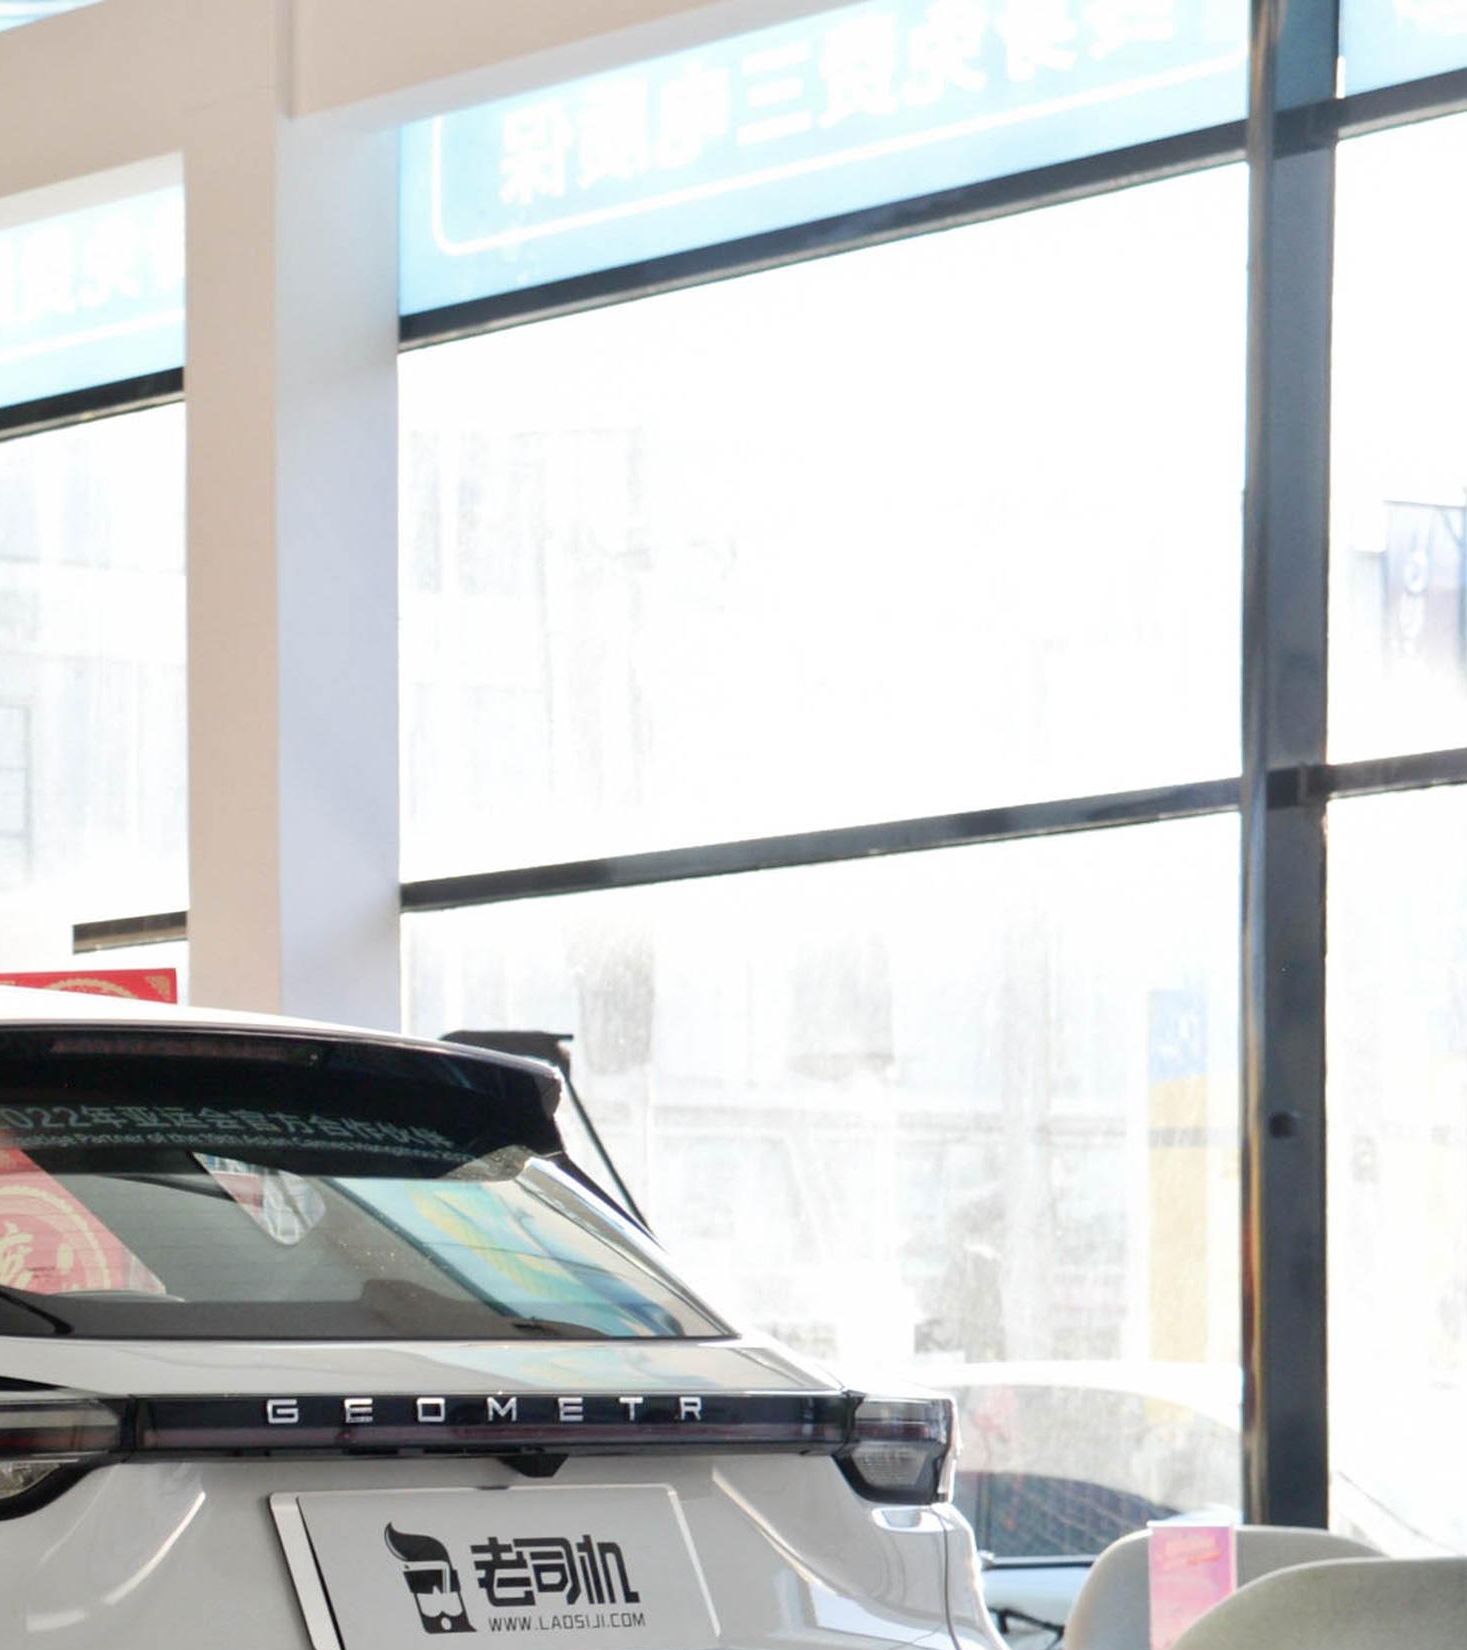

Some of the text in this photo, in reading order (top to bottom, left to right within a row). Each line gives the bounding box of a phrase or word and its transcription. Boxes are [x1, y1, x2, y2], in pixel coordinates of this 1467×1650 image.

[469, 1534, 641, 1607] 老司机
[488, 1611, 646, 1633] WWW.LAOSIJI.COM
